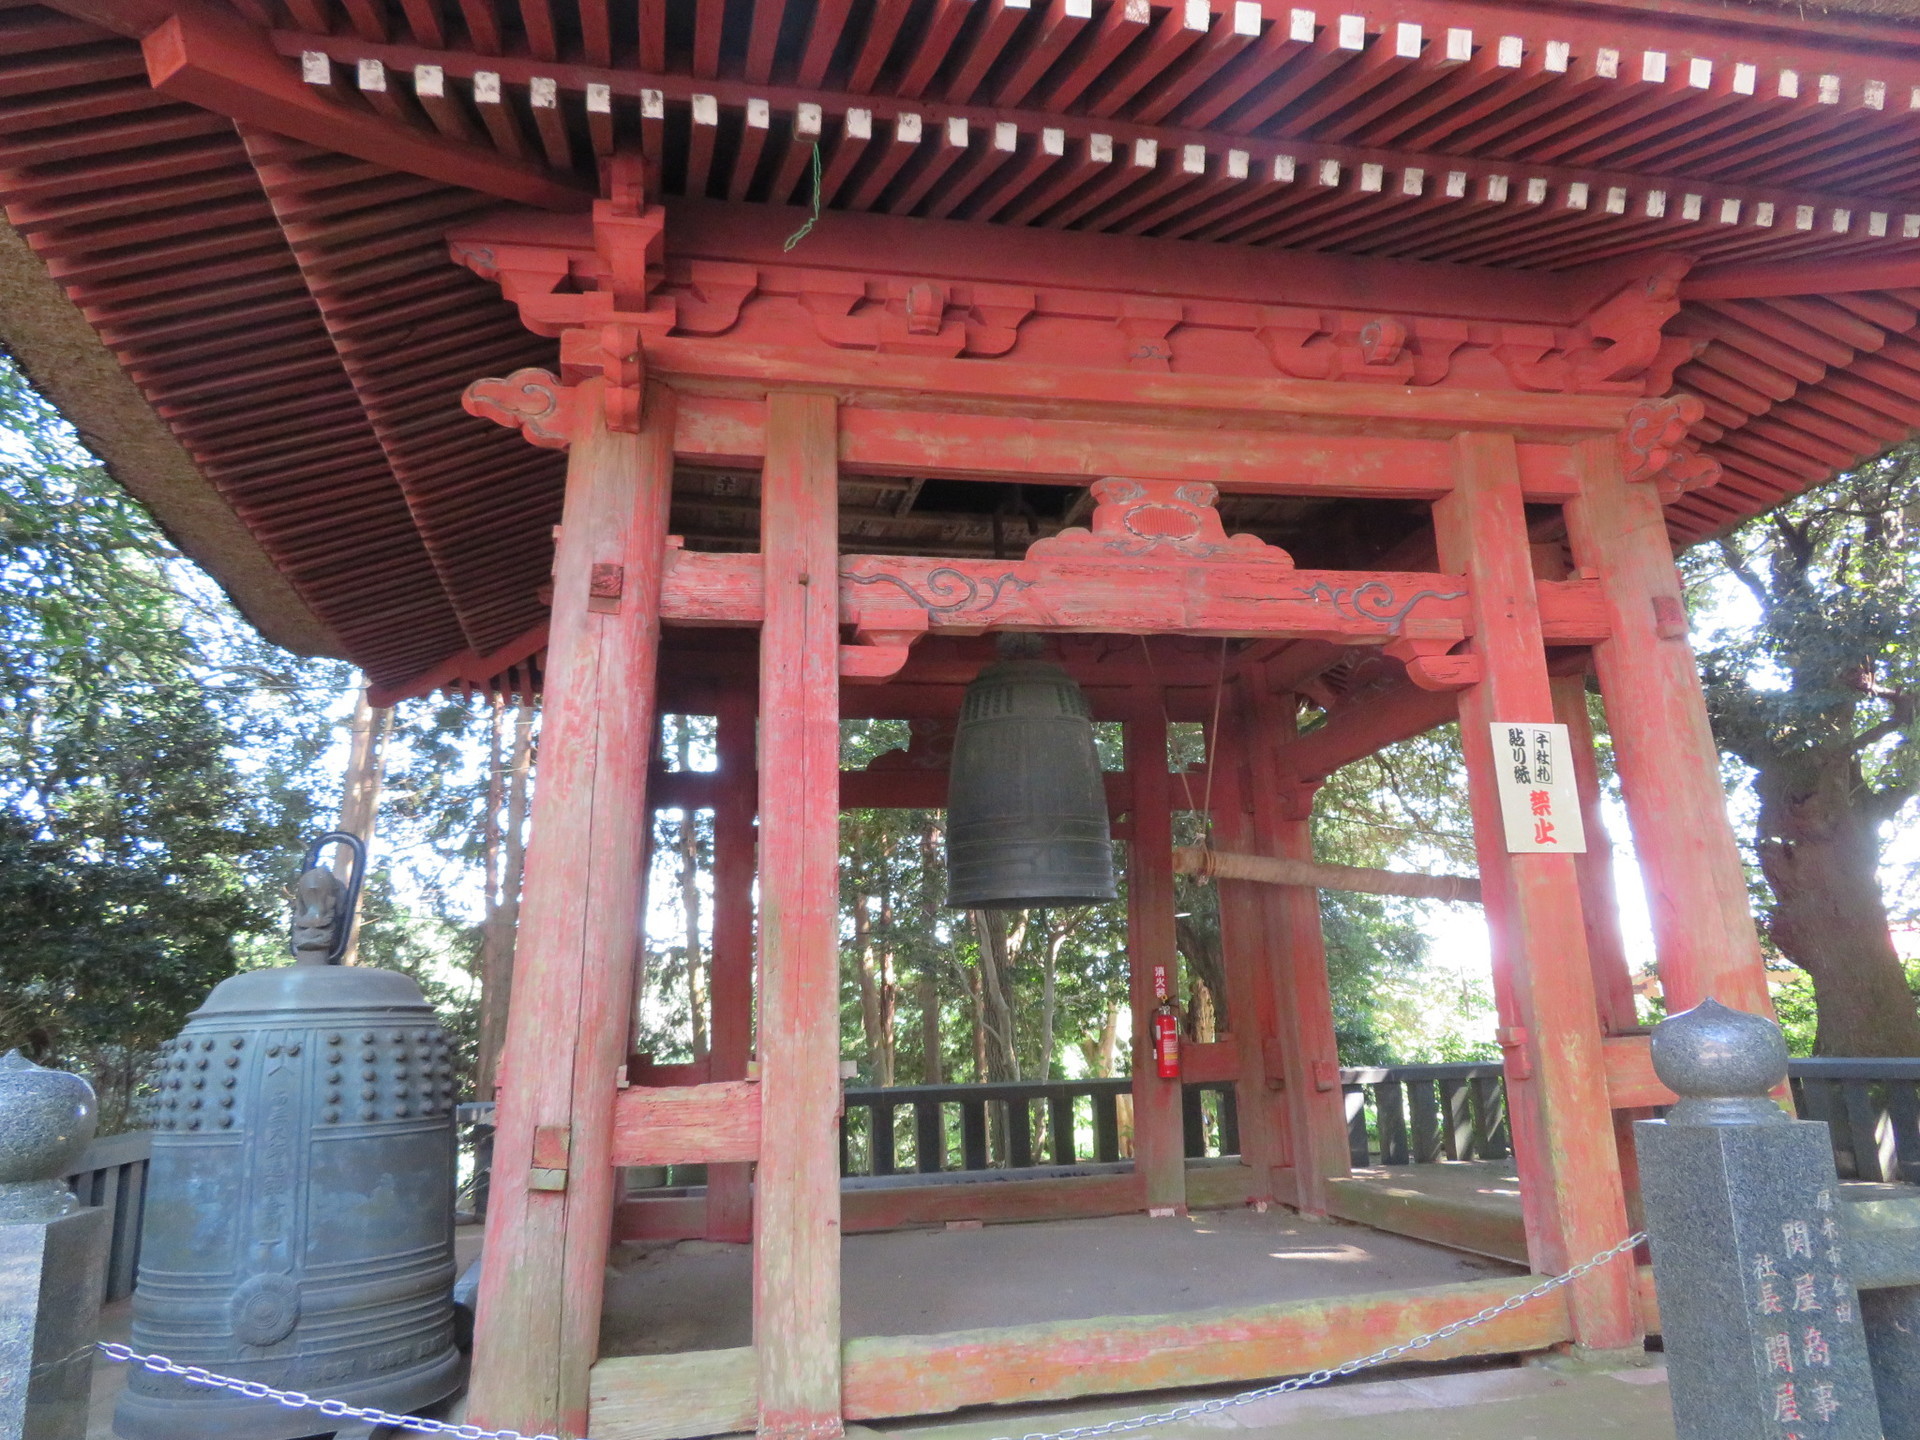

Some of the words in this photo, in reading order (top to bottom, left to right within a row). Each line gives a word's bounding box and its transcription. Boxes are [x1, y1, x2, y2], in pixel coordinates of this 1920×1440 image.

[1536, 733, 1551, 782] 千社札
[1529, 790, 1558, 845] 禁止
